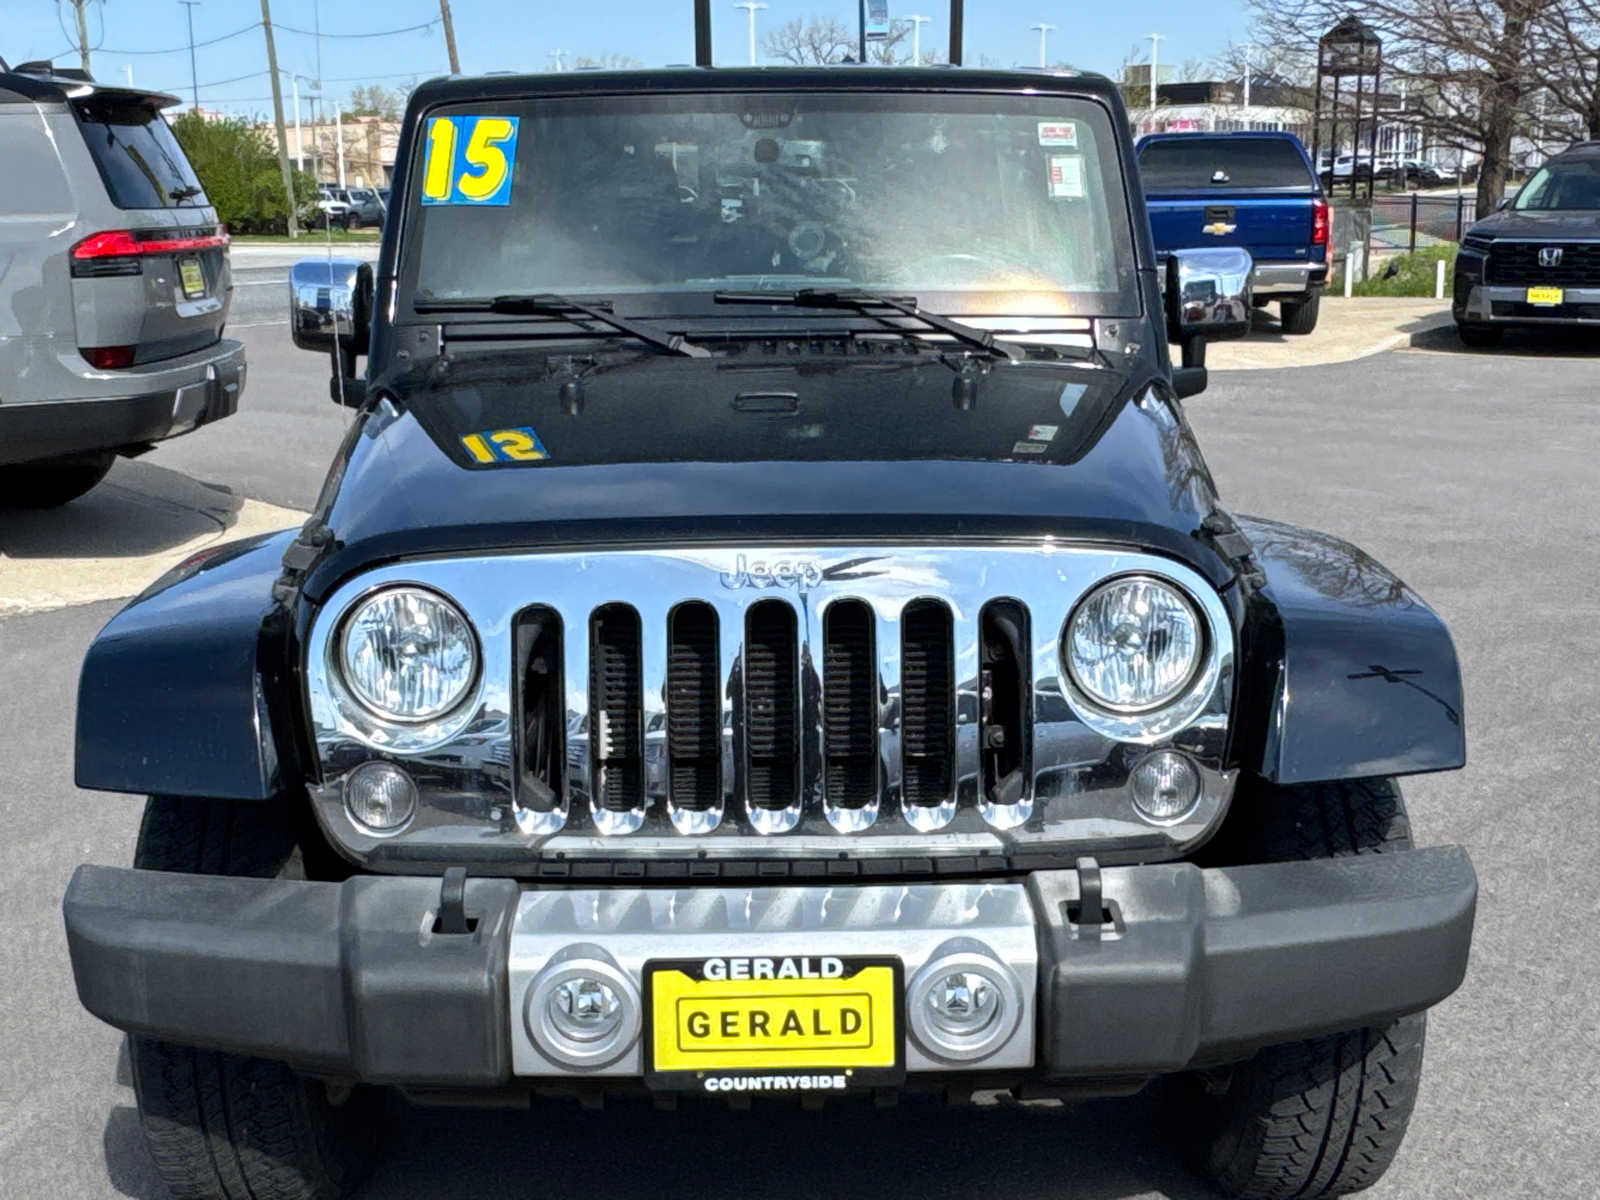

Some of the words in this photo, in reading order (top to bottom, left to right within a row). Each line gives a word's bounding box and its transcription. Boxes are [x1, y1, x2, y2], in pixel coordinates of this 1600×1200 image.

[424, 118, 514, 201] 15
[719, 553, 823, 595] Jeep
[703, 957, 844, 981] GERALD
[687, 1008, 862, 1038] GERALD
[704, 1075, 846, 1091] COUNTRYSIDE
